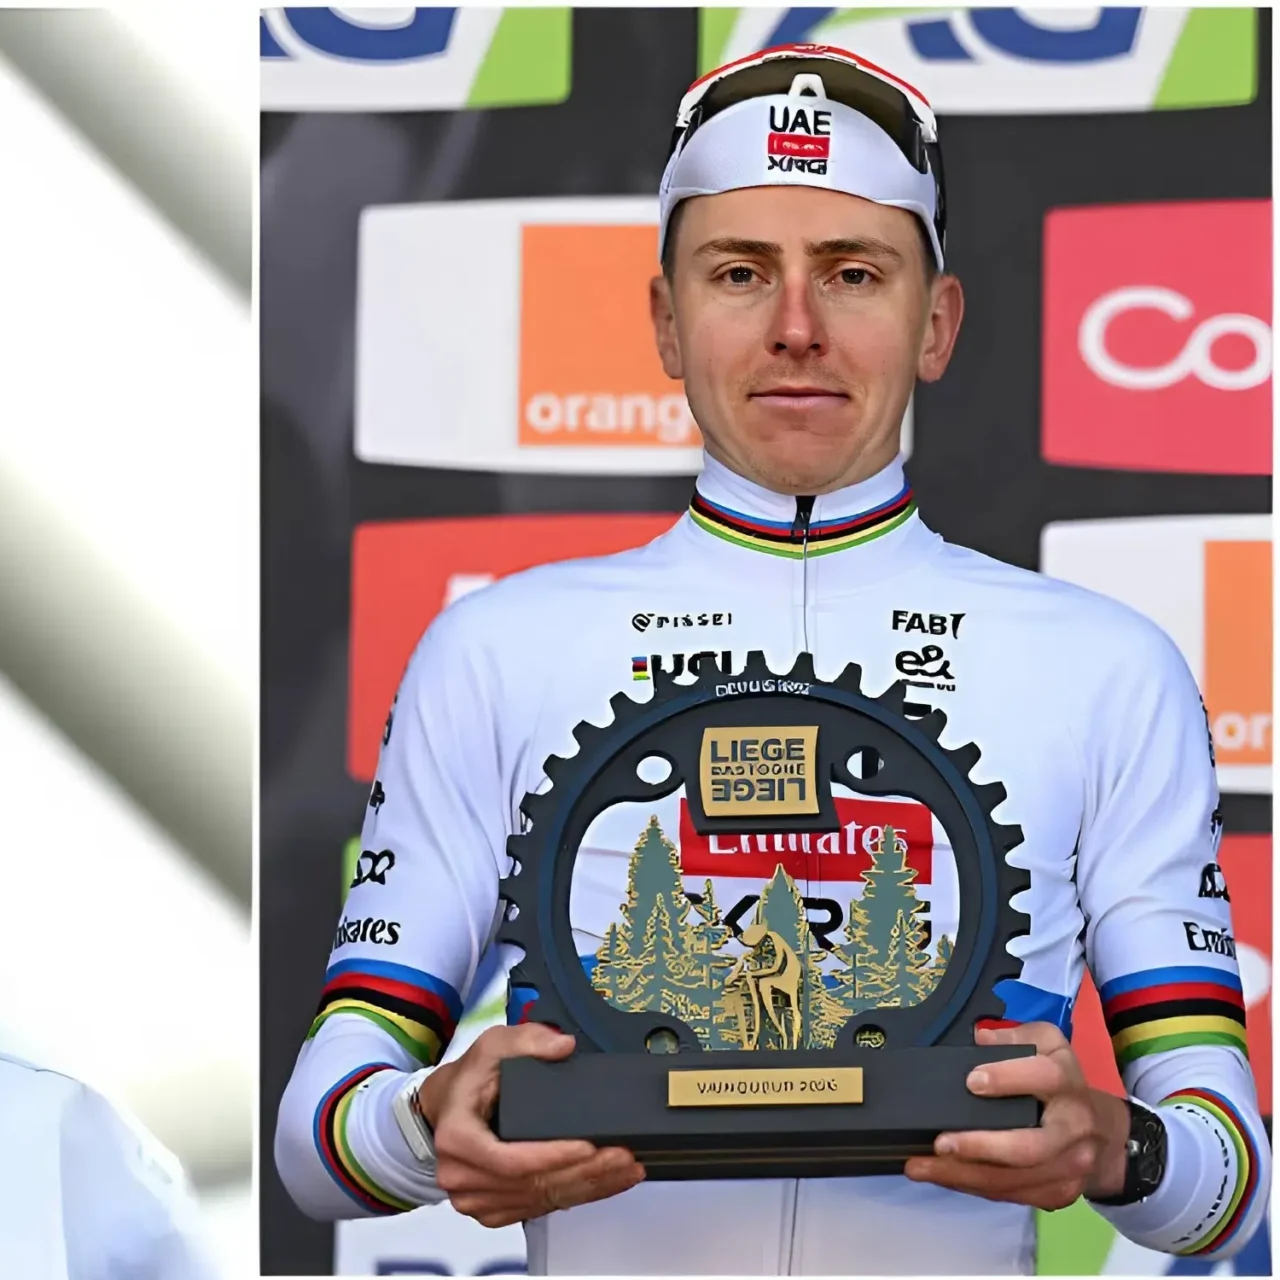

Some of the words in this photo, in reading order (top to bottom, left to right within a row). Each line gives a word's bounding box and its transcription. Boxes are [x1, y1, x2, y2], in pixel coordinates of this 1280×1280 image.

[769, 105, 832, 135] UAE
[1078, 285, 1273, 390] Co
[711, 738, 805, 763] LIEGE
[711, 777, 806, 802] LIEGE
